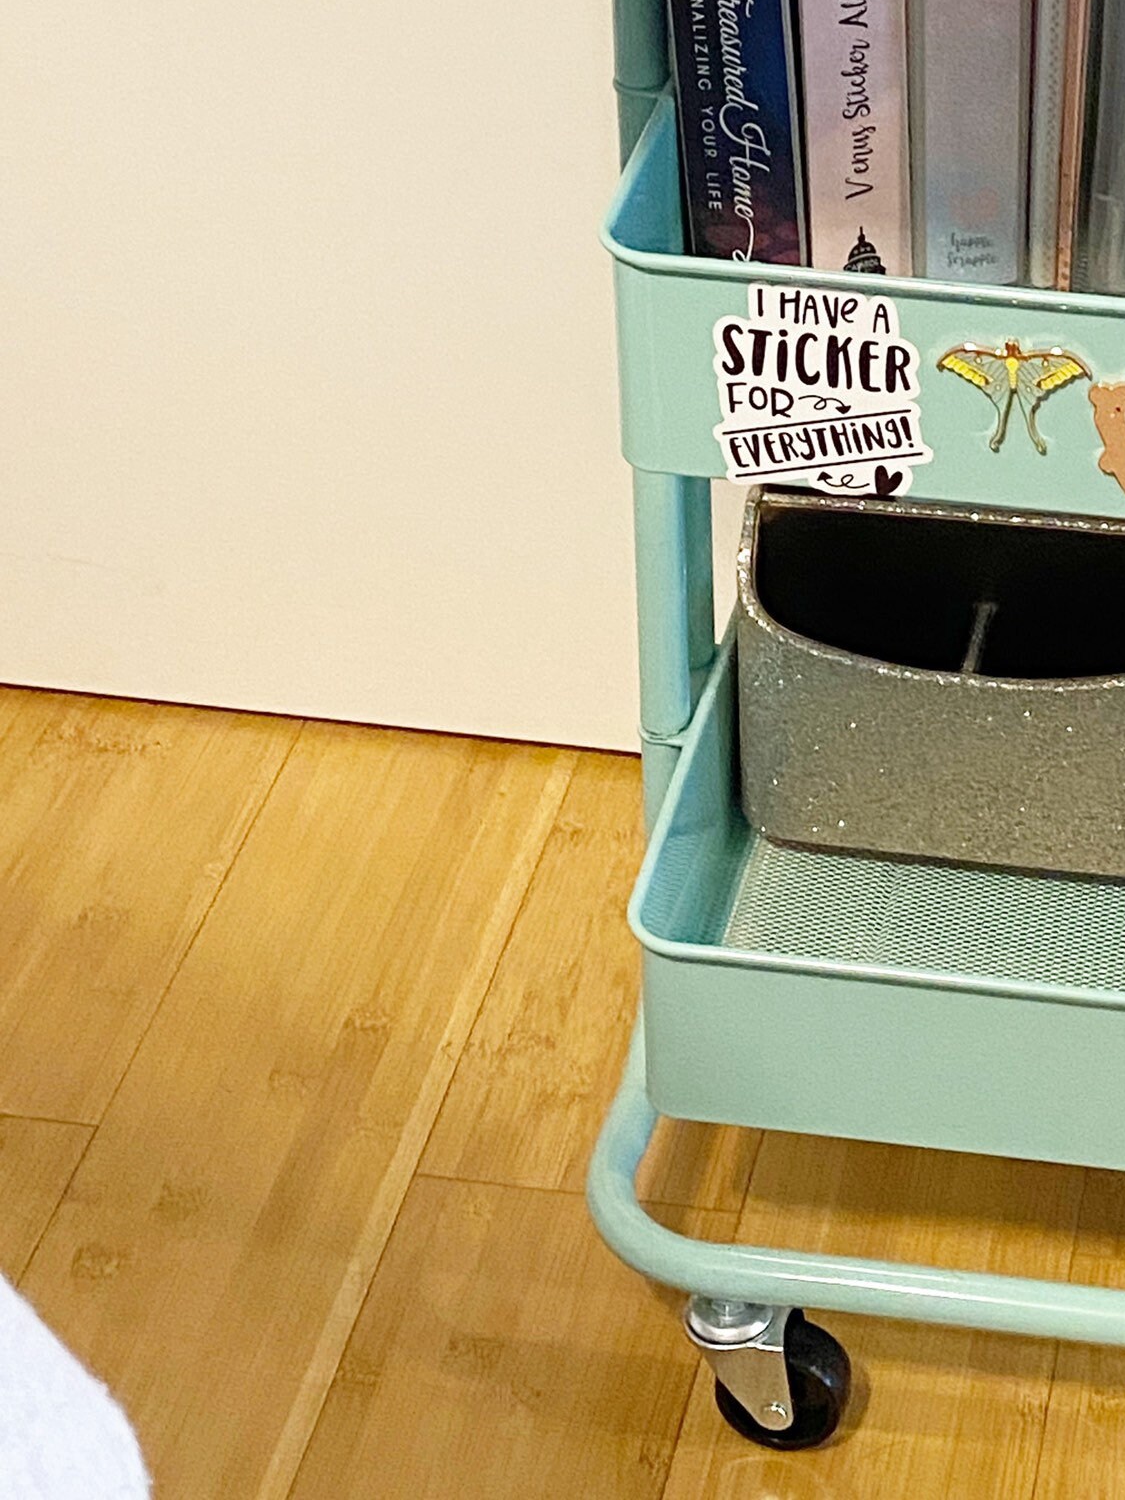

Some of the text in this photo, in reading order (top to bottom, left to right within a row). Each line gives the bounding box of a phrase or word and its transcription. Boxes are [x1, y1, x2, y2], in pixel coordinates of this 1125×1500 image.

[841, 39, 871, 120] Sticker
[701, 106, 718, 158] YOUR
[719, 103, 771, 218] Home
[845, 125, 876, 200] Venus
[706, 172, 723, 210] LIFE
[757, 288, 764, 317] I
[872, 303, 890, 334] A
[726, 382, 795, 419] FOR
